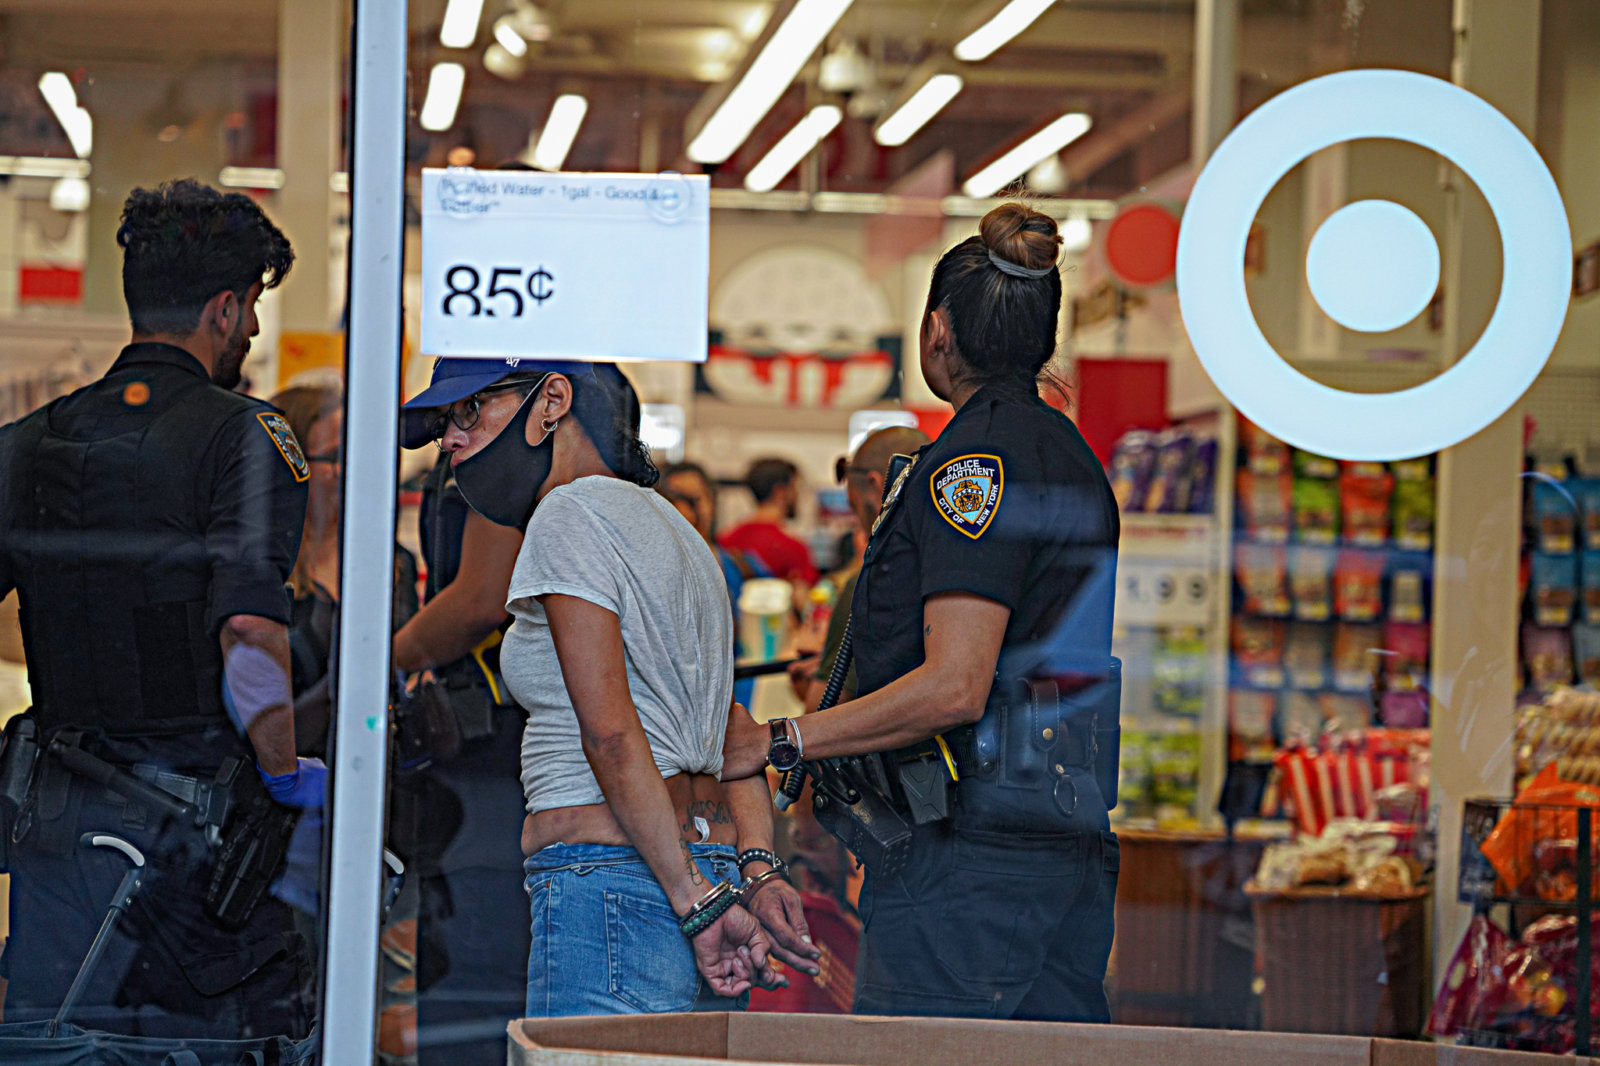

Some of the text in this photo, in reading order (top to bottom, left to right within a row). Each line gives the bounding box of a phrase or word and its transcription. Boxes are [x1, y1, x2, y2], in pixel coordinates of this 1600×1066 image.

[502, 182, 544, 196] Water
[561, 184, 590, 200] 1gal
[604, 185, 648, 200] Good
[441, 263, 554, 318] 85¢
[937, 467, 995, 490] DEPARTMENT
[947, 459, 980, 475] POLICE
[938, 484, 999, 526] CITY OF NEW YORK
